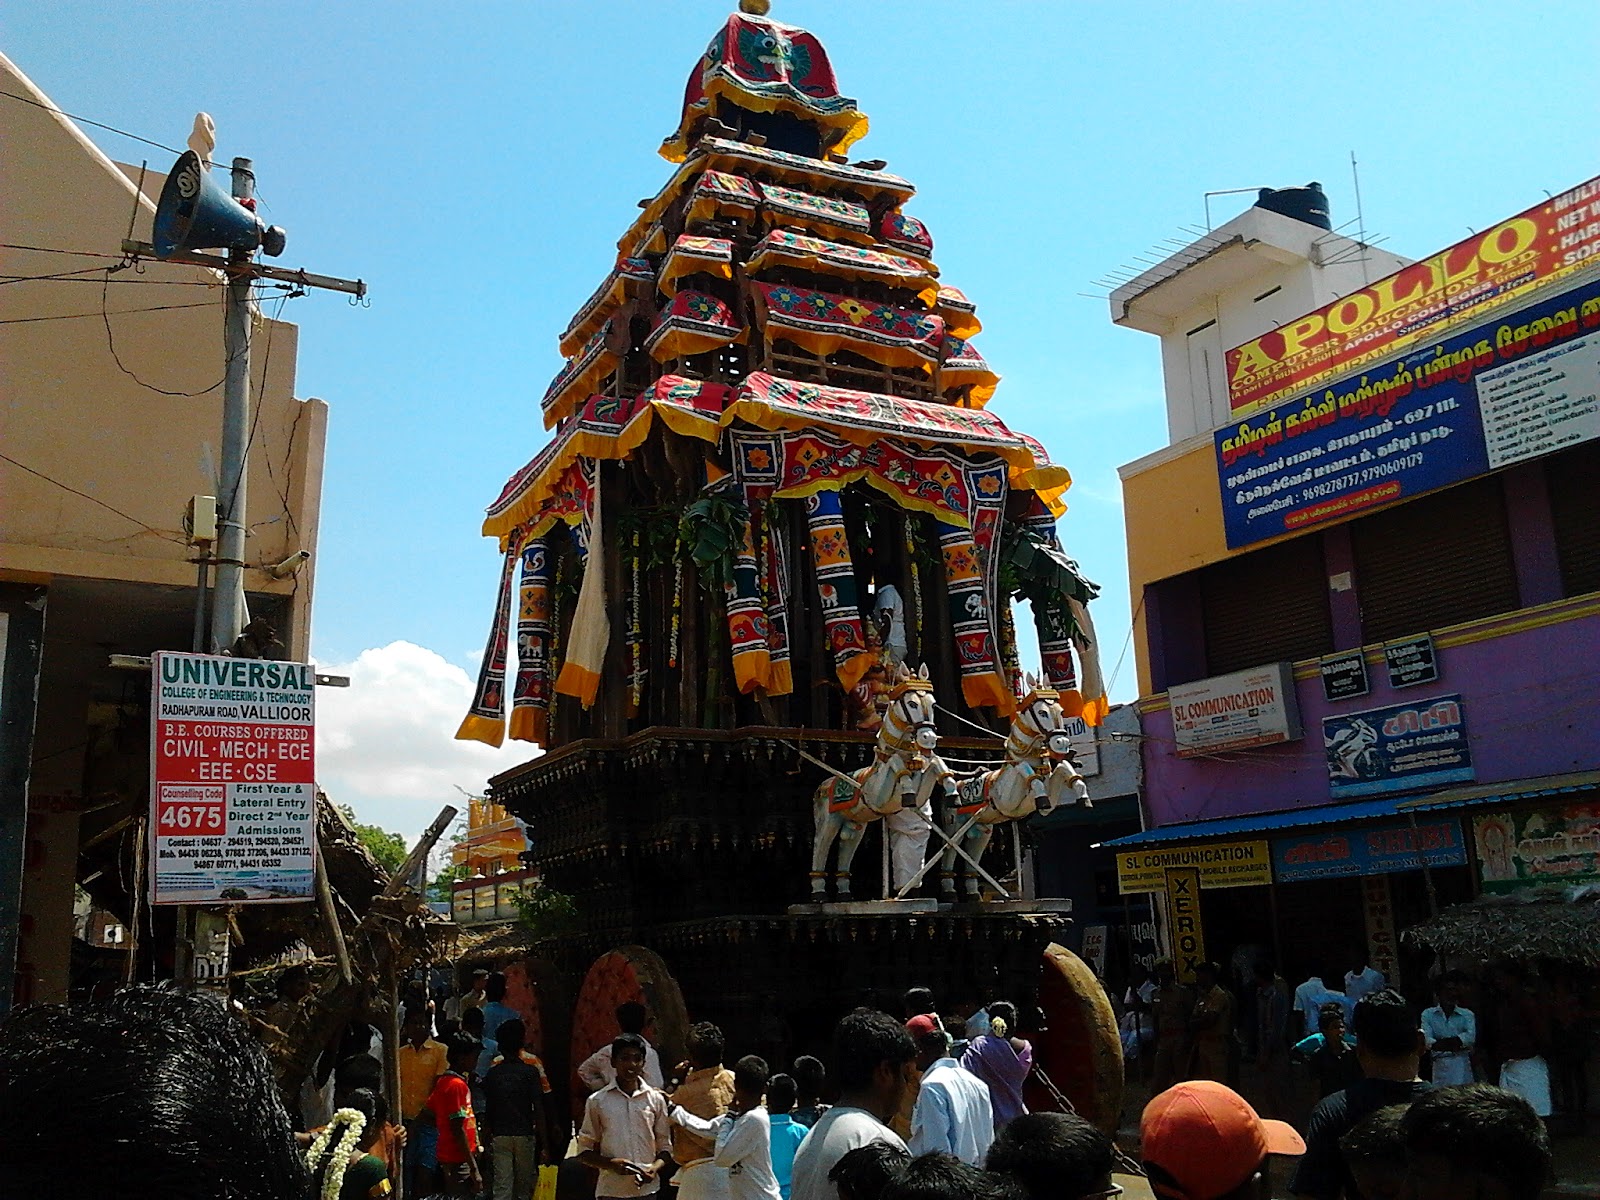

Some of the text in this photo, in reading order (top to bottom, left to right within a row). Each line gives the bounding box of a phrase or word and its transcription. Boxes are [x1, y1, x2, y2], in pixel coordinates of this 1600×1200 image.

[1554, 179, 1600, 212] MULT
[1557, 206, 1589, 232] NET
[1233, 217, 1537, 381] APOLLO
[1231, 337, 1341, 391] COMPUTER
[1346, 276, 1478, 341] EDUCATION
[1275, 365, 1306, 382] MULTI
[1344, 320, 1404, 351] APOLLO
[1406, 280, 1493, 323] COLLEGES
[1285, 389, 1338, 438] கல்வி
[1404, 405, 1433, 426] 627
[162, 657, 313, 690] UNIVERSAL
[162, 687, 311, 705] COLLEGE OF ENGINEERING & TECHNOLOGY
[1174, 705, 1188, 722] SL
[1188, 686, 1275, 719] COMMUNICATION
[162, 704, 311, 721] RADHAPURAM ROAD, VALLIOOR
[165, 724, 309, 741] B.E. COURSES OFFERED
[163, 739, 310, 761] CIVIL MECH ECE
[199, 762, 277, 781] EEE CSE
[162, 788, 223, 800] Counselling Code
[236, 784, 303, 794] First Year &
[233, 798, 306, 809] Lateral Entry
[160, 805, 222, 829] 4675
[228, 811, 310, 821] Direct 2nd Year
[237, 825, 301, 835] Admissions
[168, 838, 196, 847] Contact
[1126, 846, 1254, 869] SL COMMUNICATION
[1173, 878, 1199, 974] XEROX
